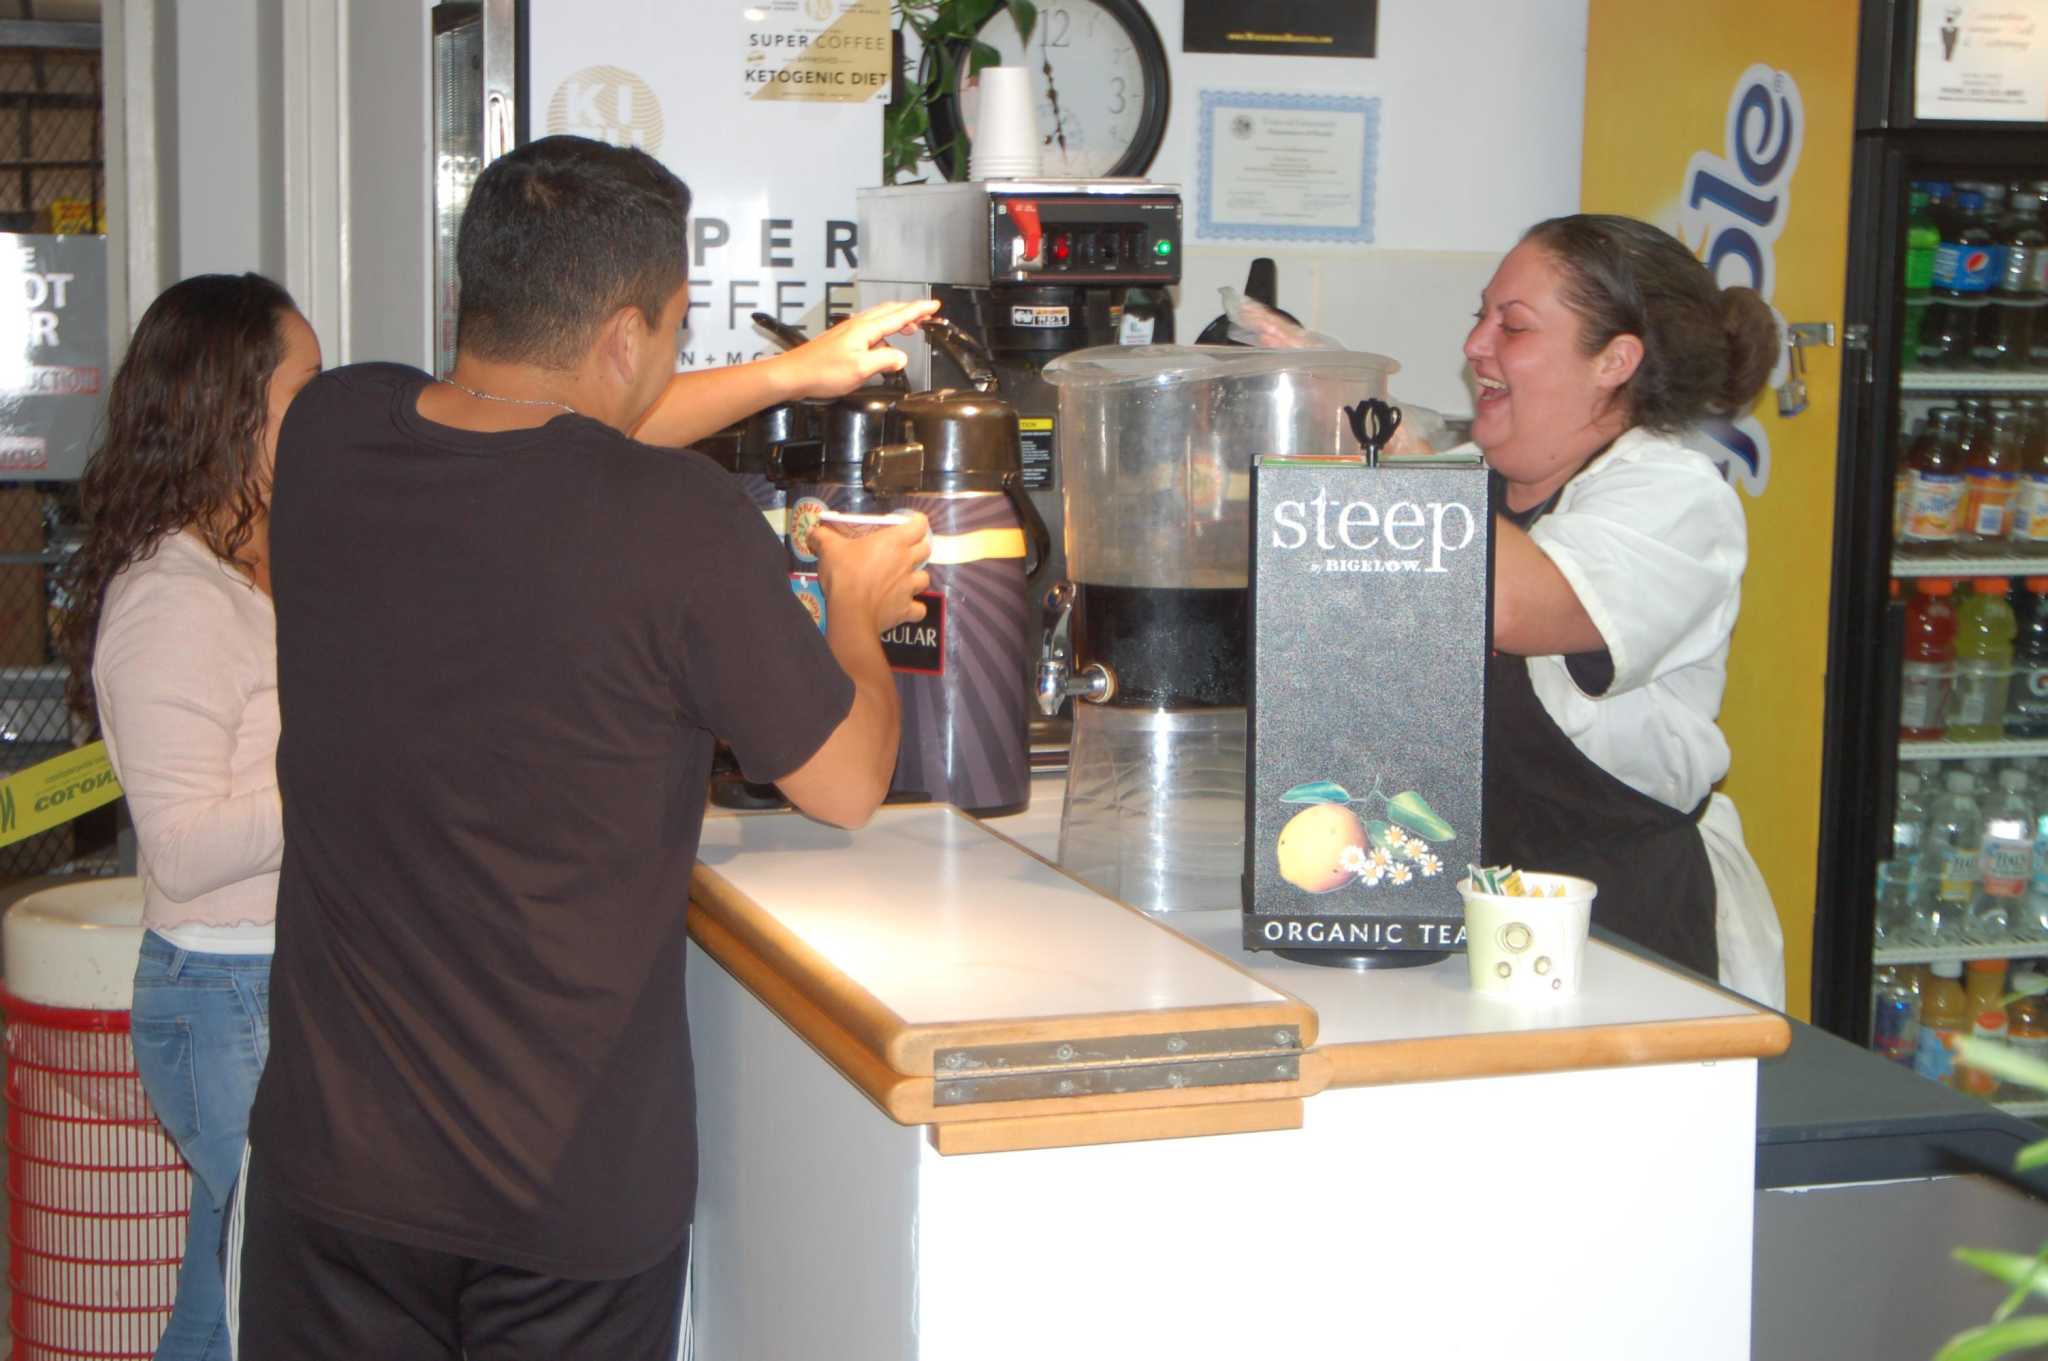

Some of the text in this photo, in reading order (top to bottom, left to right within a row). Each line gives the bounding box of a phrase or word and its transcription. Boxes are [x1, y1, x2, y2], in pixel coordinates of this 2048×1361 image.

[750, 33, 886, 51] SUPER COFFEE
[744, 69, 888, 86] KETOGENIC DIET
[1272, 487, 1475, 572] steep
[1264, 922, 1467, 943] ORGANIC TEA
